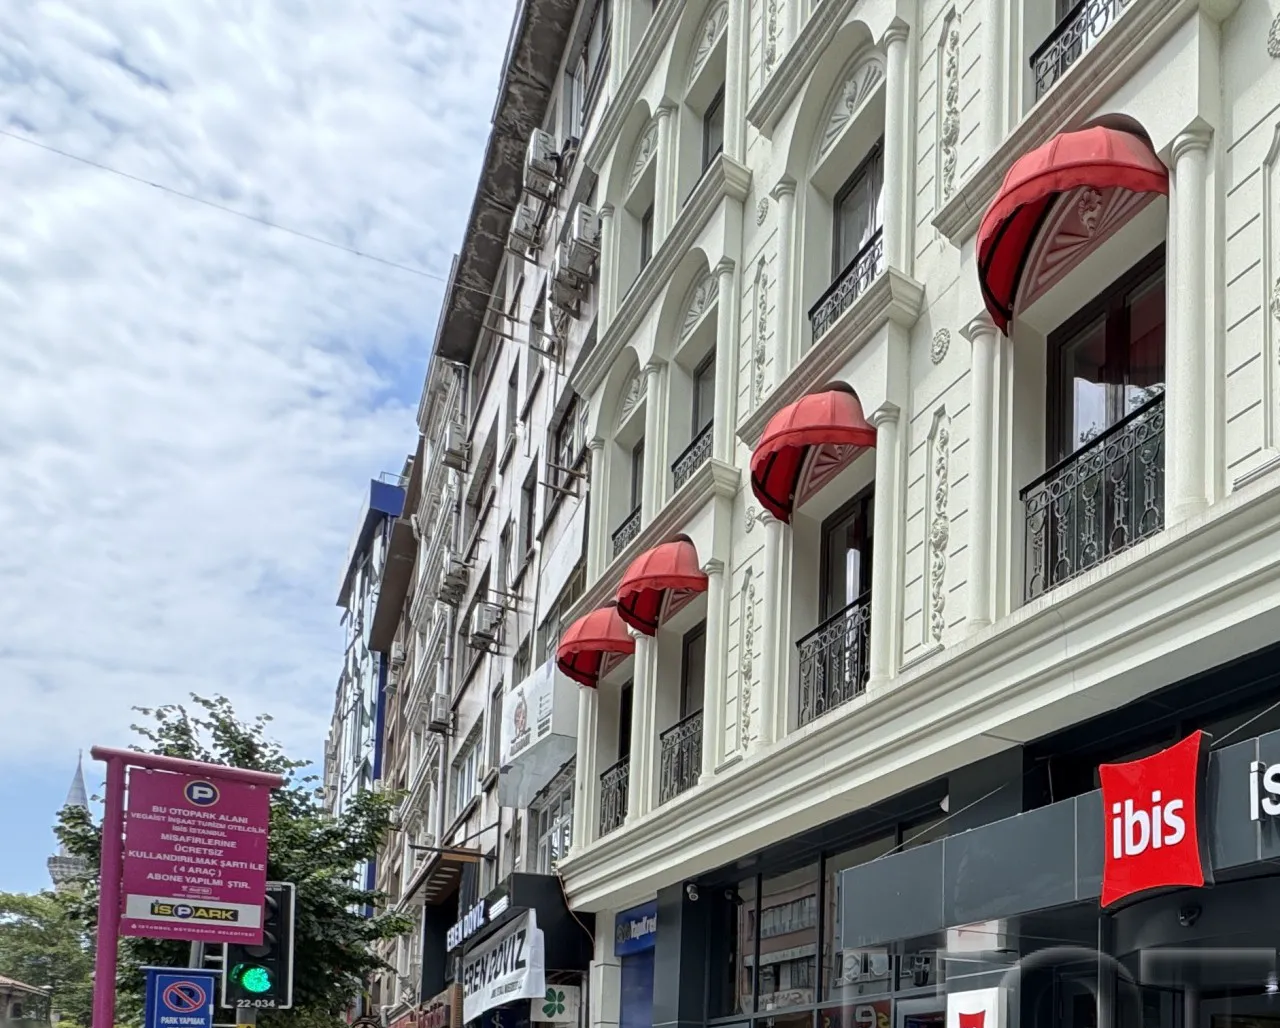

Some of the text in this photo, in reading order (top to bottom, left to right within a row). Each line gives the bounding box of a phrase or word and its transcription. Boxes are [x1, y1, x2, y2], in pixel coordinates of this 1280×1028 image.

[152, 805, 248, 824] BU OTOPARK ALANI
[1111, 798, 1186, 860] ibis
[174, 843, 224, 857] ÜCRETSİZ
[128, 850, 265, 871] KULLANDIRILMAK ŞARTI İLE
[146, 872, 183, 883] ABONE
[236, 999, 276, 1008] 22-034
[160, 1016, 205, 1026] PARK YAPMAK
